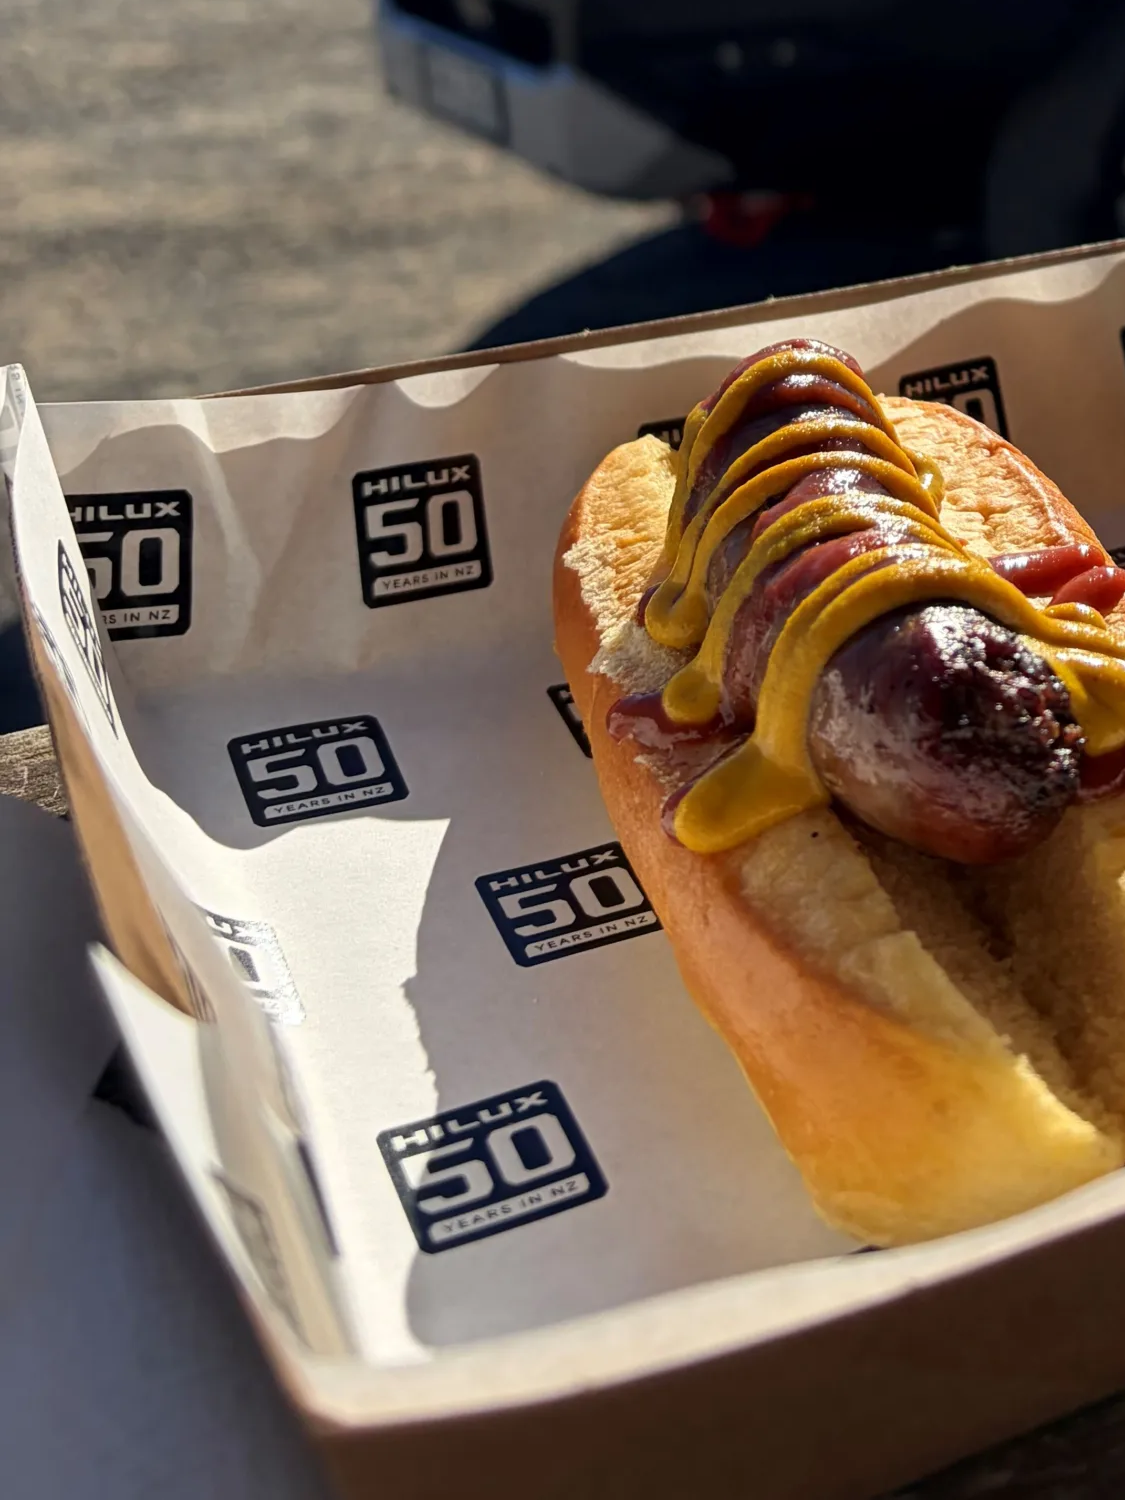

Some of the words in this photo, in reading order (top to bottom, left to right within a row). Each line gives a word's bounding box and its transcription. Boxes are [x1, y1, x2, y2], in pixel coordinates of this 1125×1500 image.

[905, 366, 989, 396] HILUX
[362, 465, 471, 497] HILUX
[365, 489, 478, 568] 50
[381, 573, 430, 591] YEARS
[434, 569, 449, 580] IN
[454, 565, 475, 578] NZ
[123, 611, 141, 622] IN
[148, 609, 172, 621] NZ
[240, 721, 369, 755] HILUX
[246, 736, 386, 799] 50
[273, 796, 331, 814] YEARS
[338, 792, 356, 802] IN
[362, 786, 386, 797] NZ
[489, 849, 619, 892] HILUX
[498, 866, 645, 937] 50
[534, 930, 593, 952] YEARS
[600, 923, 618, 935] IN
[624, 915, 650, 927] NZ
[390, 1091, 549, 1152] HILUX
[400, 1112, 577, 1216] 50
[441, 1204, 512, 1234] YEARS
[519, 1193, 543, 1209] IN
[550, 1179, 580, 1197] NZ
